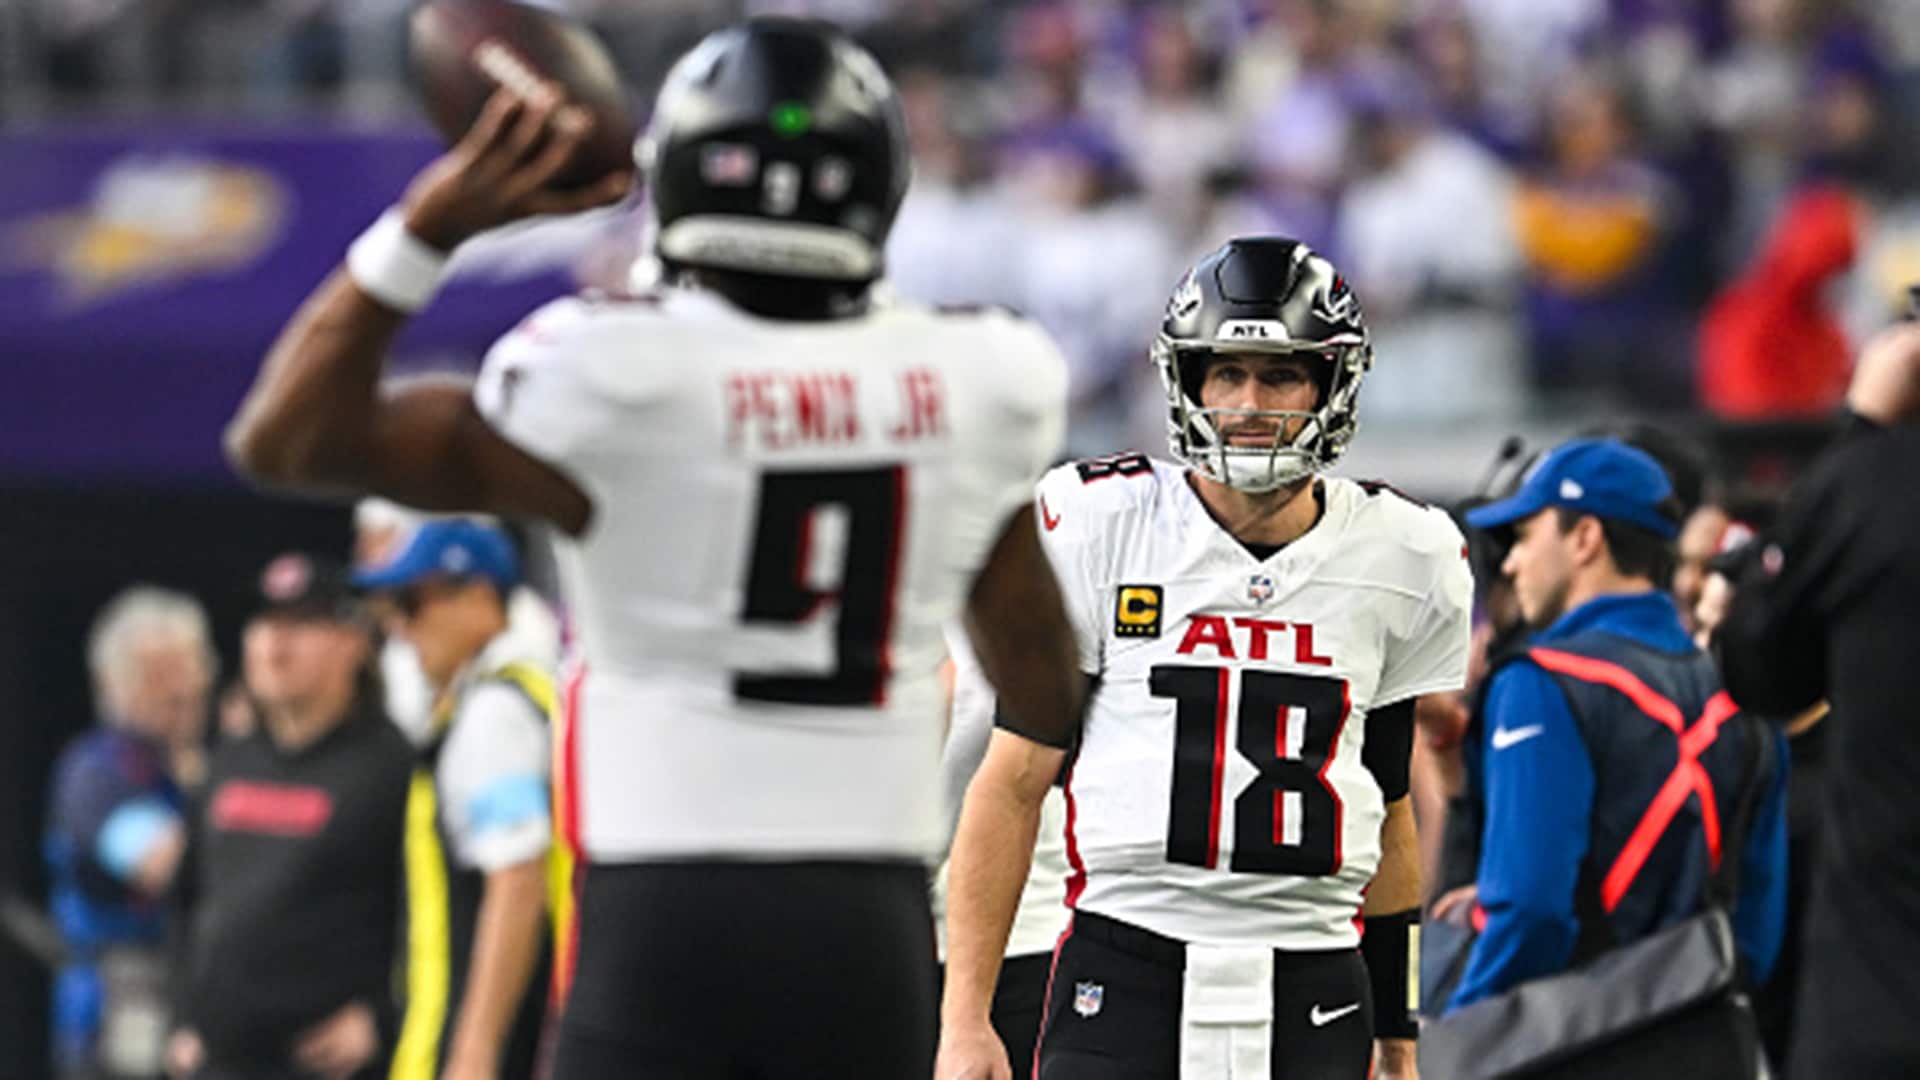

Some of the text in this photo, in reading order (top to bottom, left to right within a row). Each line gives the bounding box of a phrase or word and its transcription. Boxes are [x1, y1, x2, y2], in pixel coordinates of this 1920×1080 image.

[1232, 325, 1269, 337] ATL
[732, 463, 907, 708] 9
[1118, 587, 1157, 625] C
[1176, 614, 1332, 667] ATL
[1149, 663, 1352, 877] 18
